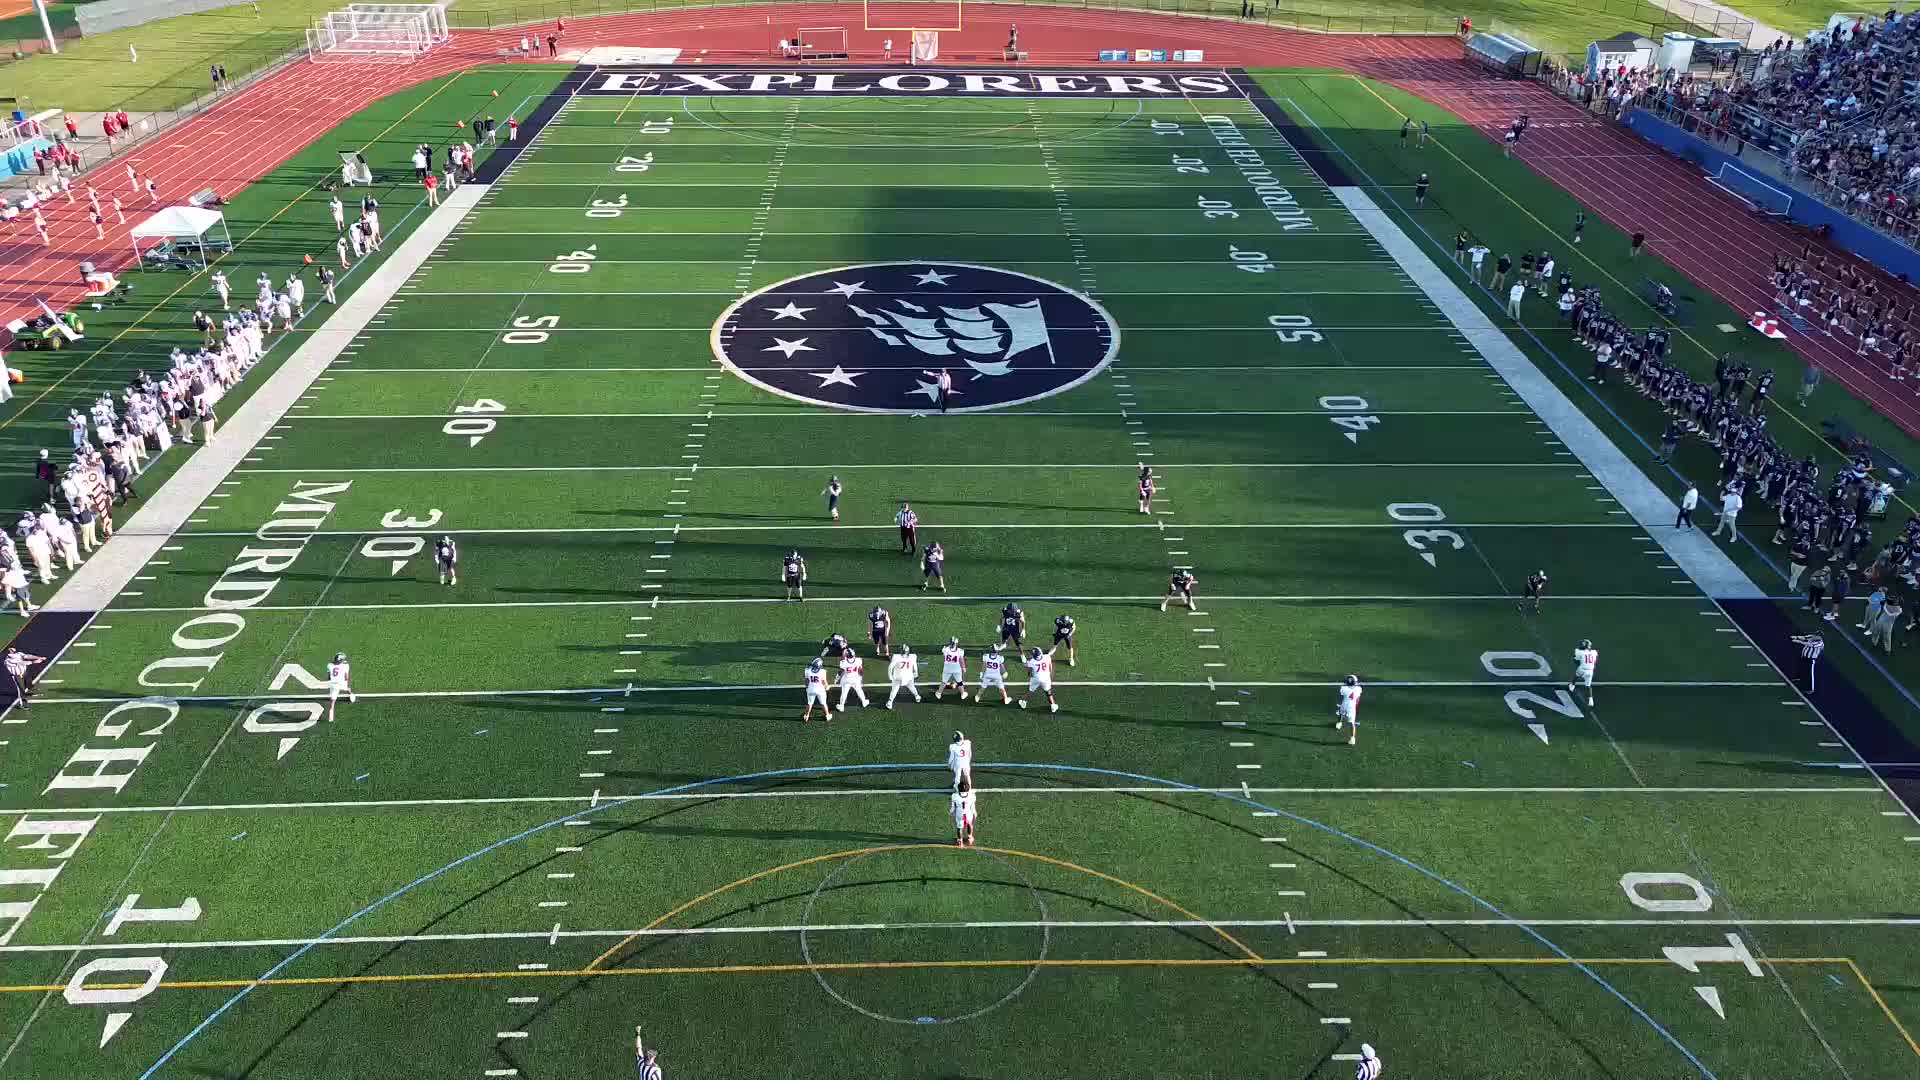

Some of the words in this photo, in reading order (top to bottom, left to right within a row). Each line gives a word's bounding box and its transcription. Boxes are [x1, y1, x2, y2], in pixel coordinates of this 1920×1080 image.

[598, 73, 1230, 94] EXPLORERS
[640, 121, 674, 134] 10
[1151, 122, 1184, 135] 10
[614, 156, 653, 171] 20
[1172, 158, 1209, 173] 20
[1226, 149, 1319, 231] MURDOUGH
[585, 199, 628, 218] 30
[1197, 200, 1239, 218] 30
[549, 250, 596, 273] 40
[1229, 251, 1275, 273] 40
[502, 315, 560, 344] 50
[1267, 315, 1323, 342] 50
[442, 398, 507, 435] 40
[1319, 395, 1381, 430] 40
[360, 509, 444, 558] 30
[1386, 503, 1464, 549] 30
[41, 478, 354, 796] MURDOUGH
[946, 655, 958, 663] 64
[986, 662, 999, 670] 59
[1584, 654, 1594, 664] 10
[332, 667, 340, 677] 6
[1348, 691, 1354, 700] 4
[1480, 651, 1584, 718] 20
[1619, 872, 1764, 977] 10
[64, 894, 203, 1004] 10
